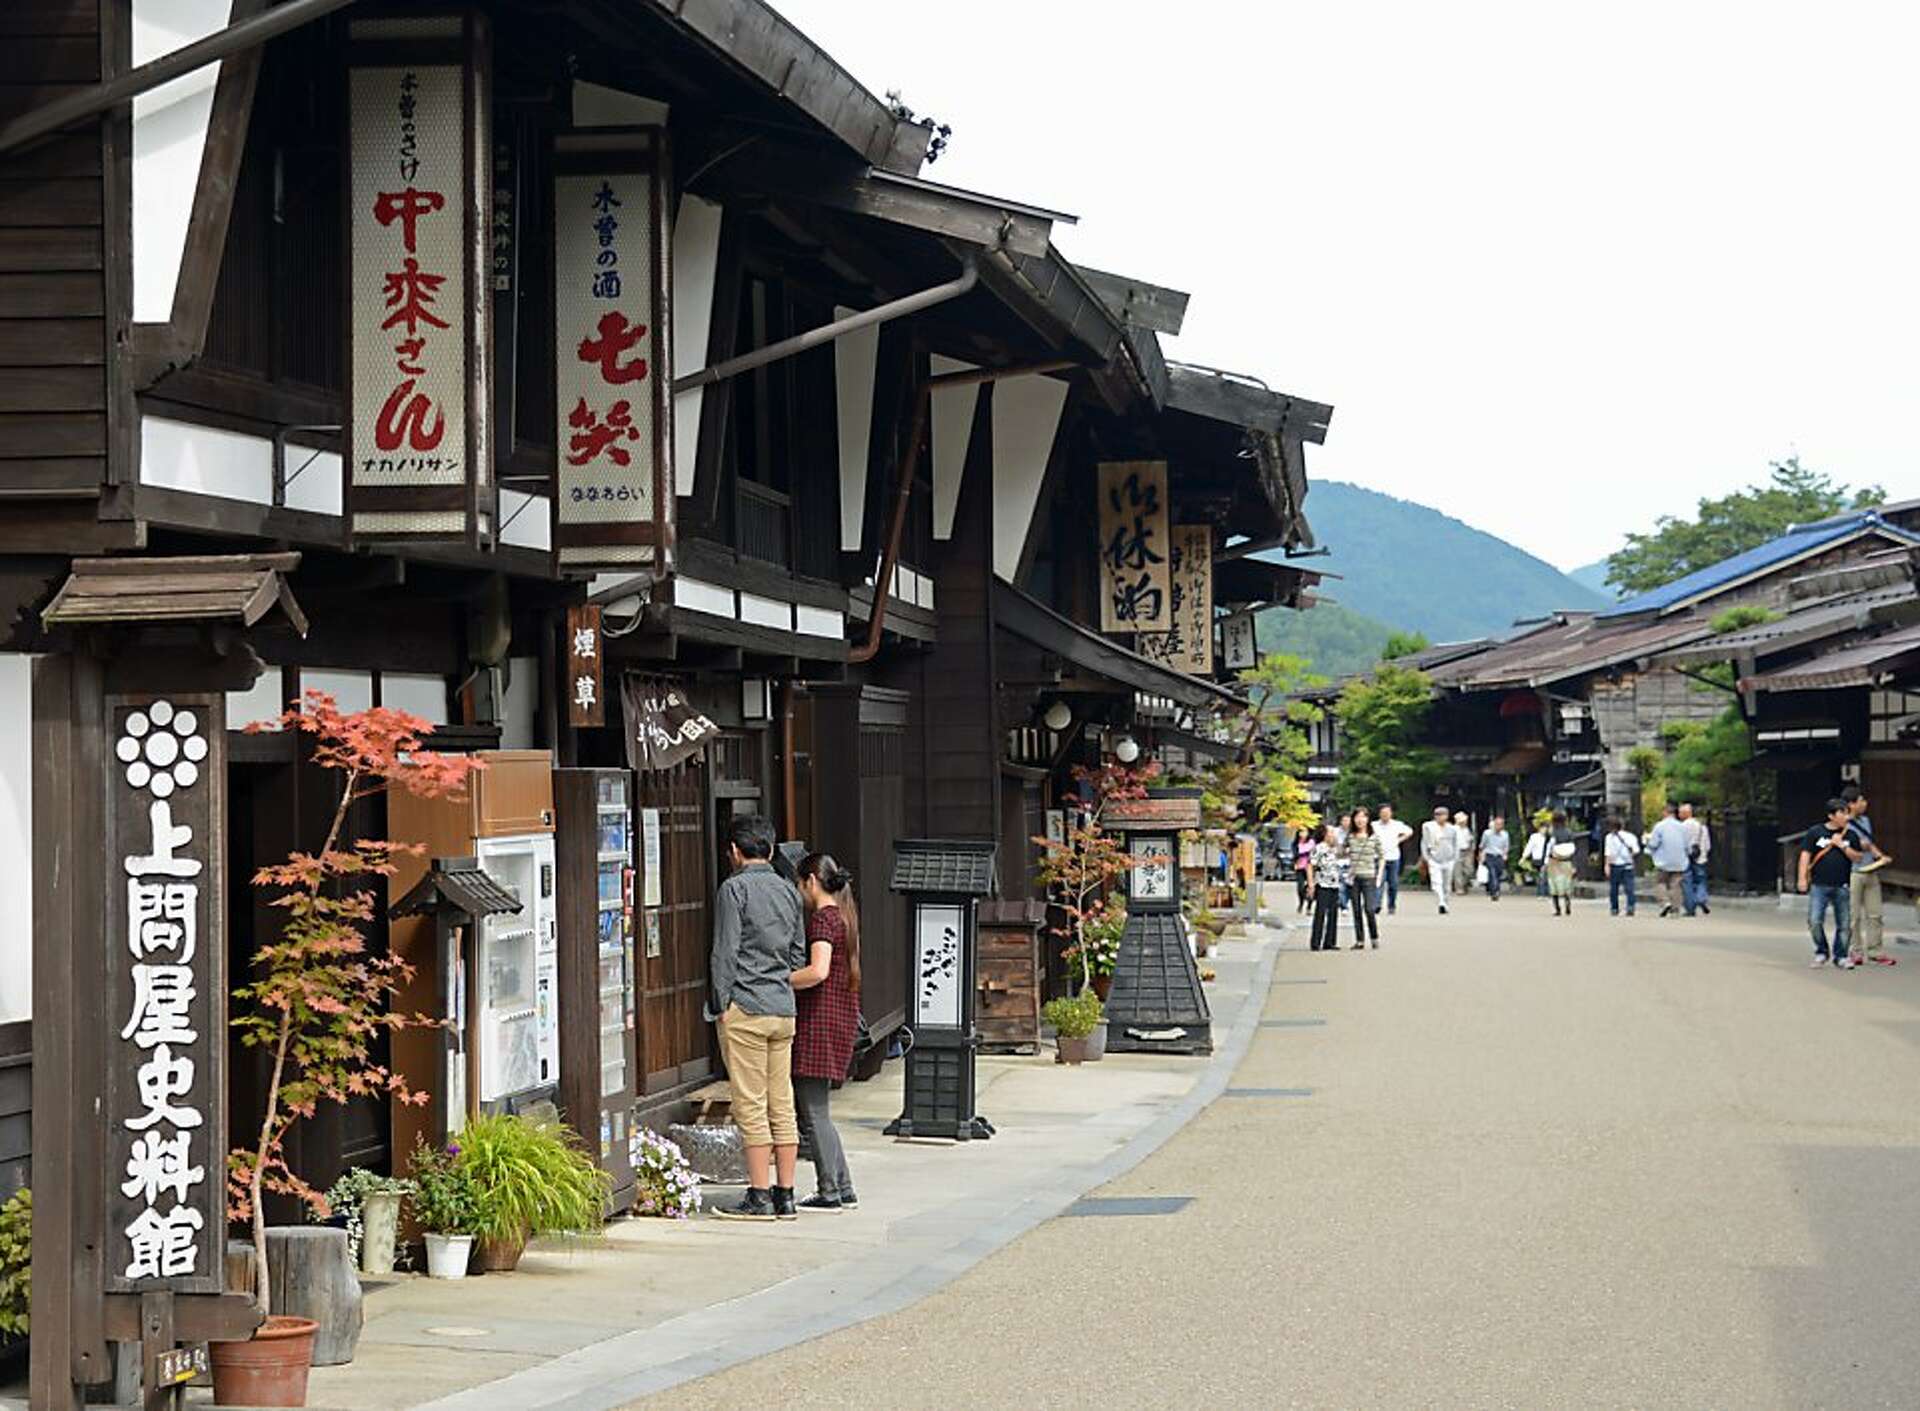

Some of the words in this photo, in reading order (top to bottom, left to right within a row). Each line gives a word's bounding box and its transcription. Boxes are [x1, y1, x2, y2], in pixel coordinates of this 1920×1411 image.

[566, 311, 647, 467] 七笑
[361, 458, 458, 472] ナカノリサン
[574, 628, 596, 710] 煙草
[121, 799, 204, 1279] 上問屋史料館
